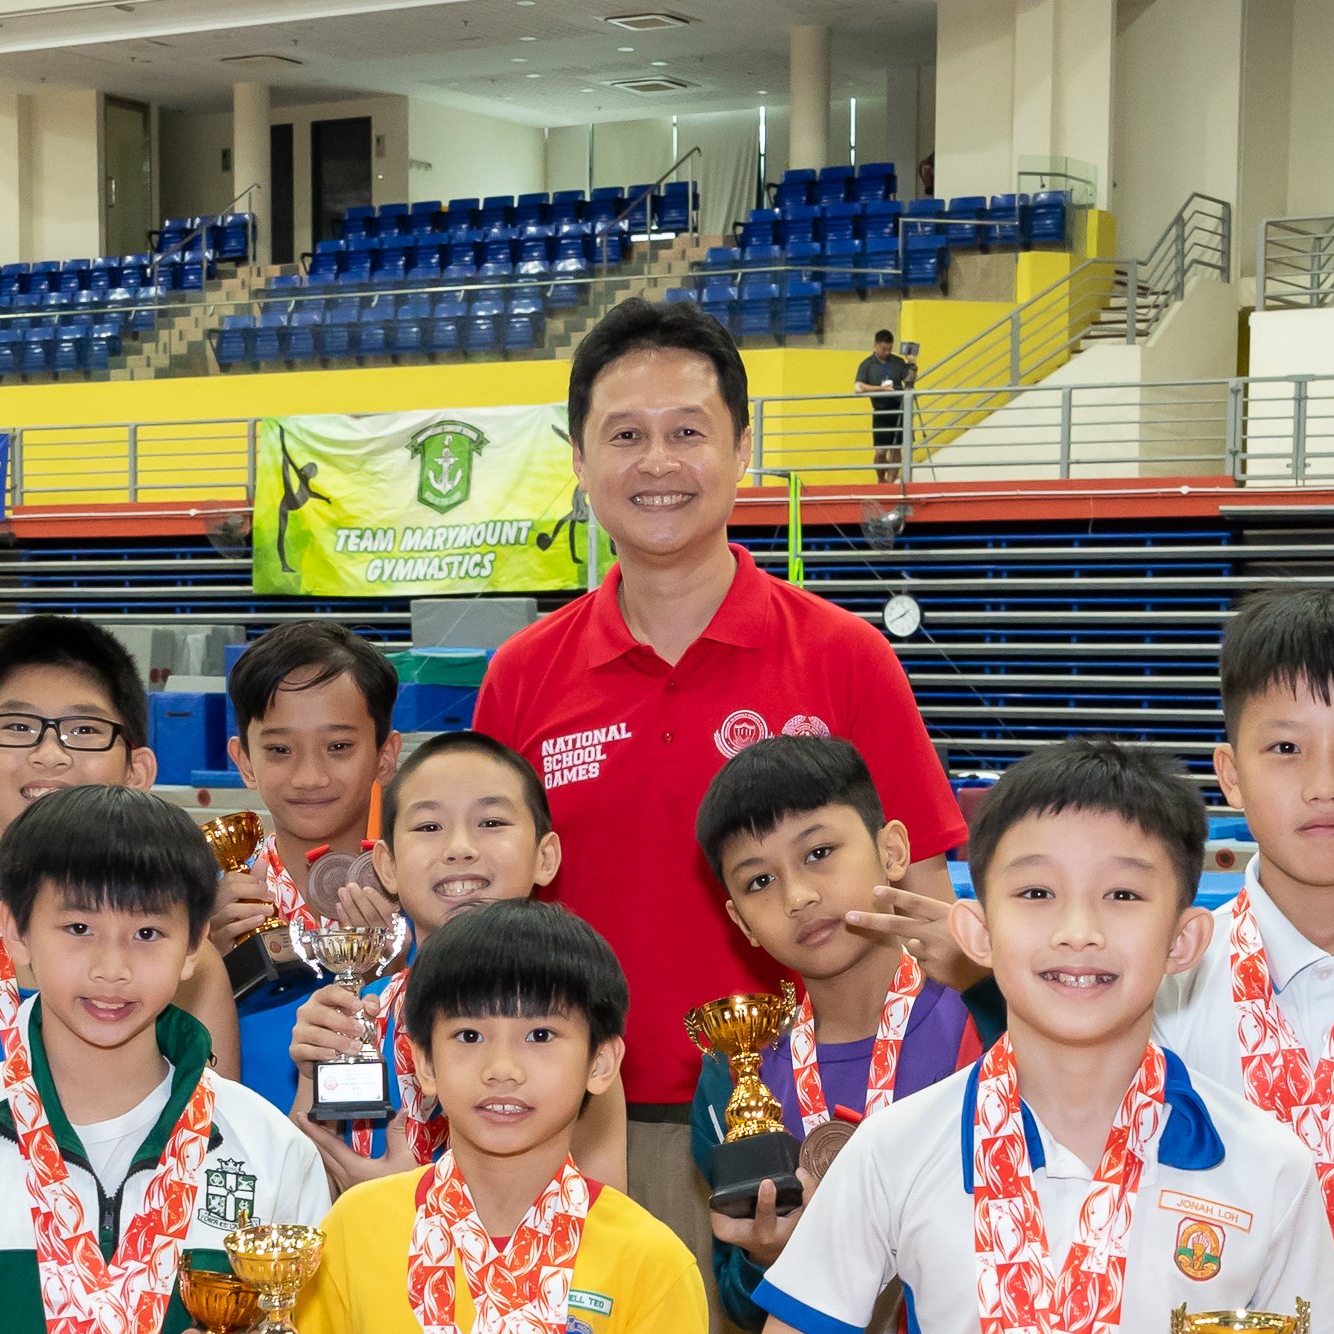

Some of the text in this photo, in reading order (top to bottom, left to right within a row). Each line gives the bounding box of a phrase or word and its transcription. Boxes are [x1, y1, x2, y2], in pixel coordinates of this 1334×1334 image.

[333, 519, 534, 553] TEAM MARYMOUNT
[365, 552, 496, 582] GYMNASTICS
[541, 722, 632, 757] NATIONAL
[543, 745, 606, 773] SCHOOL
[545, 762, 600, 789] GAMES
[1177, 1199, 1239, 1222] JONAH LOH
[589, 1297, 605, 1308] TEO
